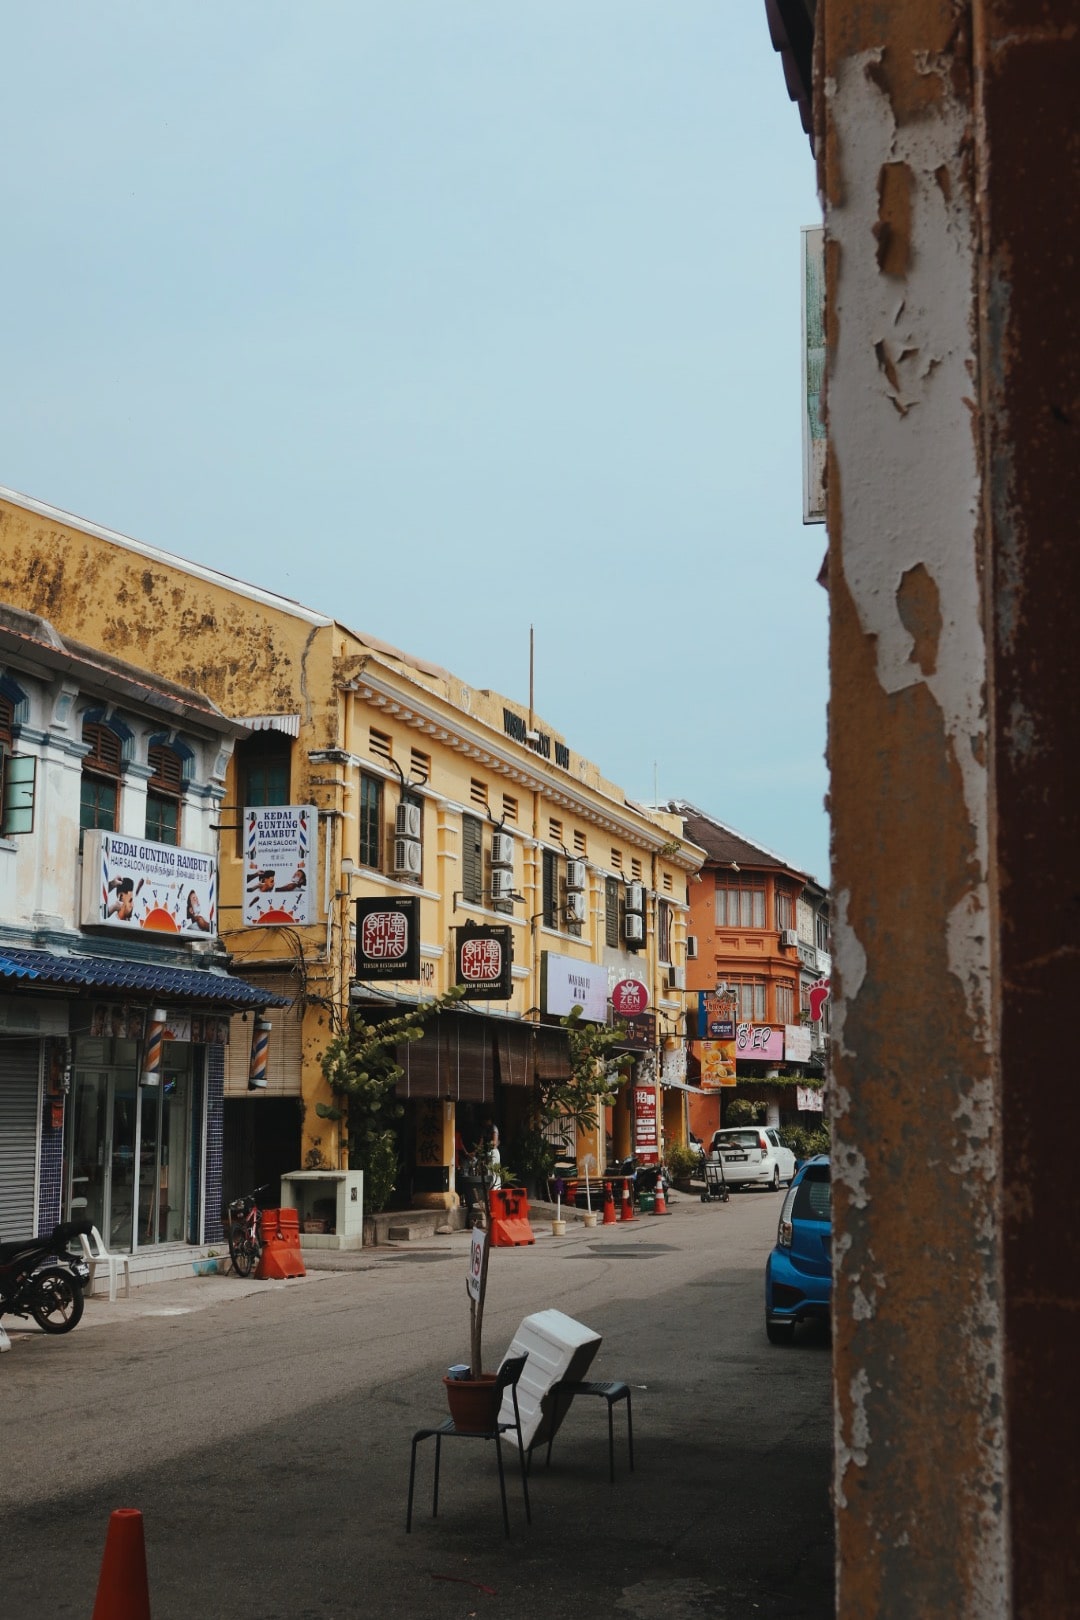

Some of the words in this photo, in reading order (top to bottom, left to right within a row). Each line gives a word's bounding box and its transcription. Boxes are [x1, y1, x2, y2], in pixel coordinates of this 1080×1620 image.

[264, 811, 292, 820] KEDAI
[257, 820, 298, 829] GUNTING
[259, 830, 297, 838] RAMBUT
[111, 840, 138, 858] KEDAI
[139, 846, 175, 866] GUNTING
[177, 854, 208, 872] RAMBUT
[110, 856, 124, 866] HAIR
[124, 859, 145, 871] SALOON
[620, 995, 640, 1004] ZEN
